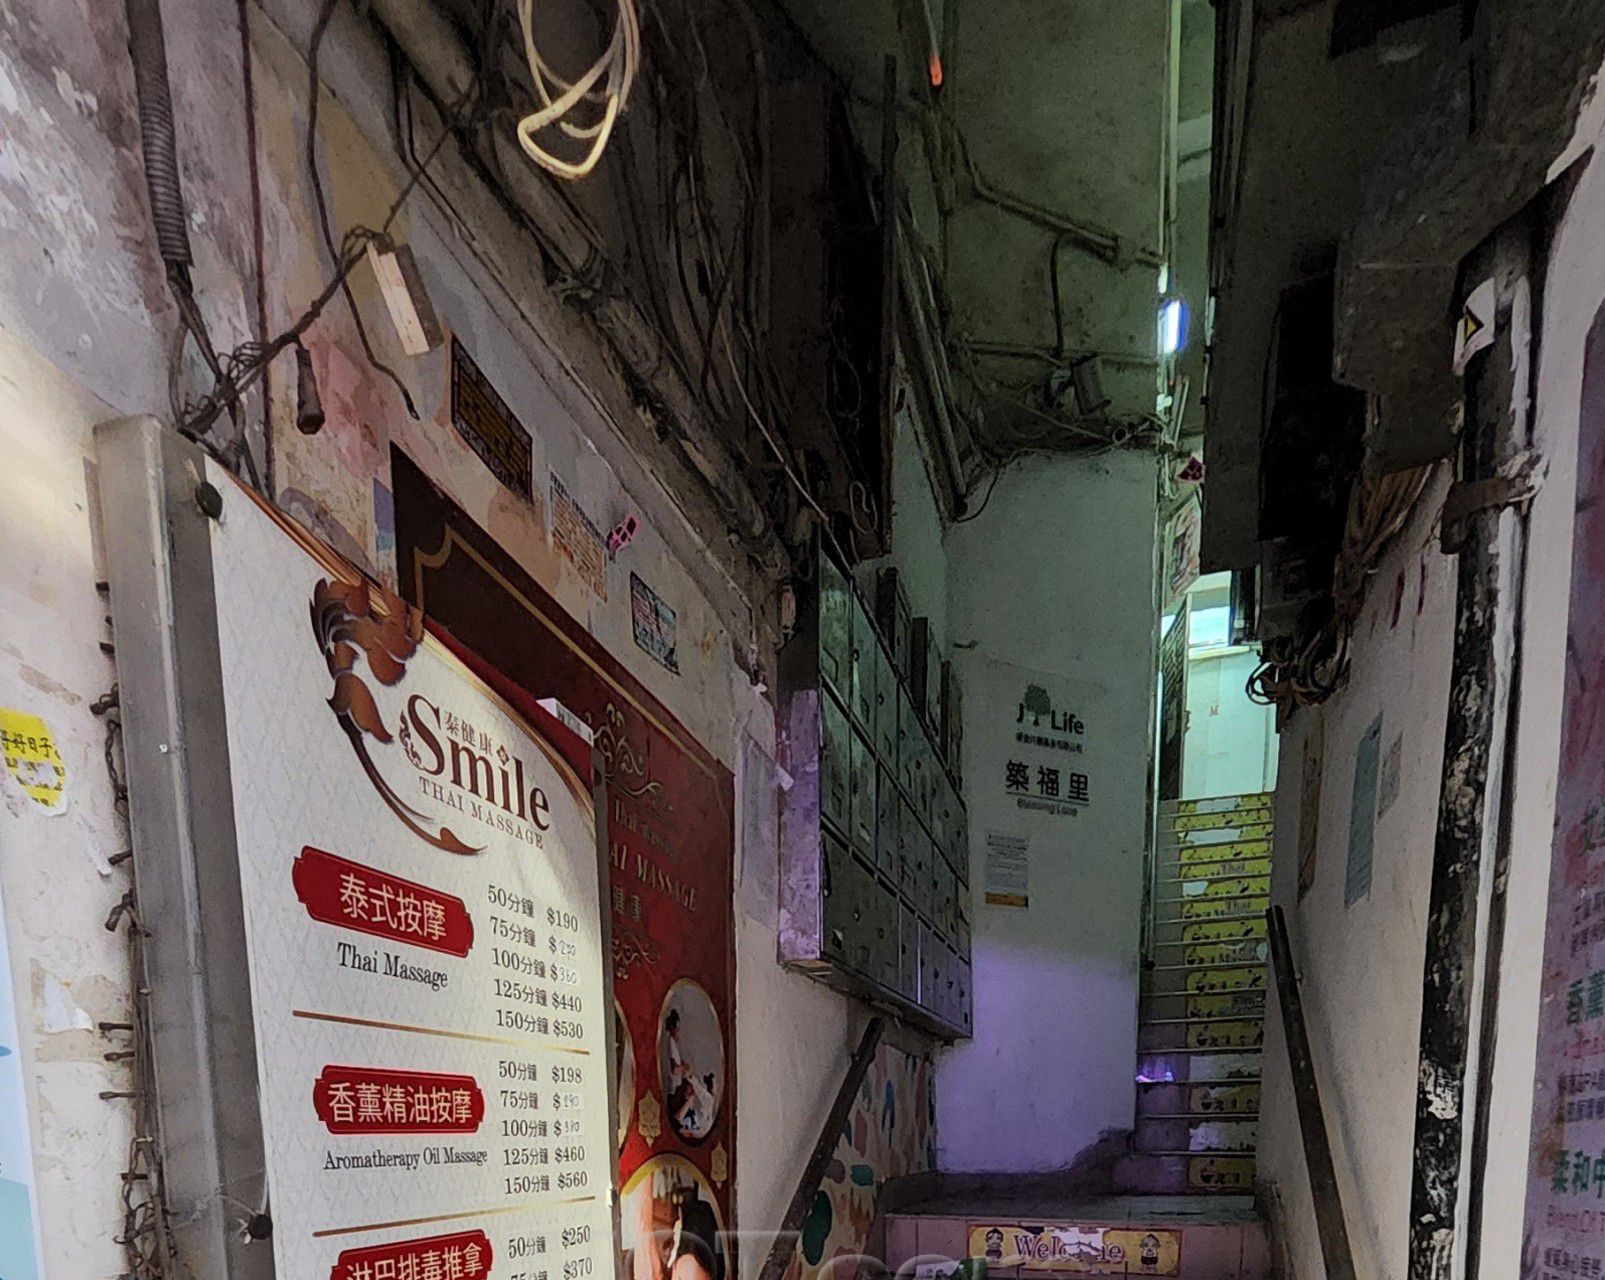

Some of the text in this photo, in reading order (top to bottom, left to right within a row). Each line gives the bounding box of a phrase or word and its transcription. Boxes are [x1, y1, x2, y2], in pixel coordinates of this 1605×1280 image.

[1050, 709, 1085, 735] Life
[406, 694, 550, 831] Smile
[419, 776, 544, 850] THAI MASSAGE
[338, 873, 448, 941] 泰式按摩
[488, 884, 579, 933] 50分鐘 $190
[489, 915, 537, 948] 75分鐘
[337, 941, 449, 991] Thai Massage
[491, 948, 546, 979] 100分鐘
[493, 979, 582, 1013] 125分鐘 $440
[496, 1009, 583, 1039] 150分鐘 $530
[498, 1061, 583, 1084] 50分鐘 $198
[328, 1082, 473, 1124] 香薰精油按摩
[500, 1090, 538, 1110] 75分鐘
[501, 1119, 548, 1138] 100分鐘
[323, 1147, 488, 1171] Aromatherapy Oil Massage
[503, 1145, 585, 1166] 125分鐘 $460
[504, 1170, 588, 1195] 150分鐘 $560
[507, 1224, 591, 1259] 50分鐘 $250
[563, 1256, 593, 1280] $370
